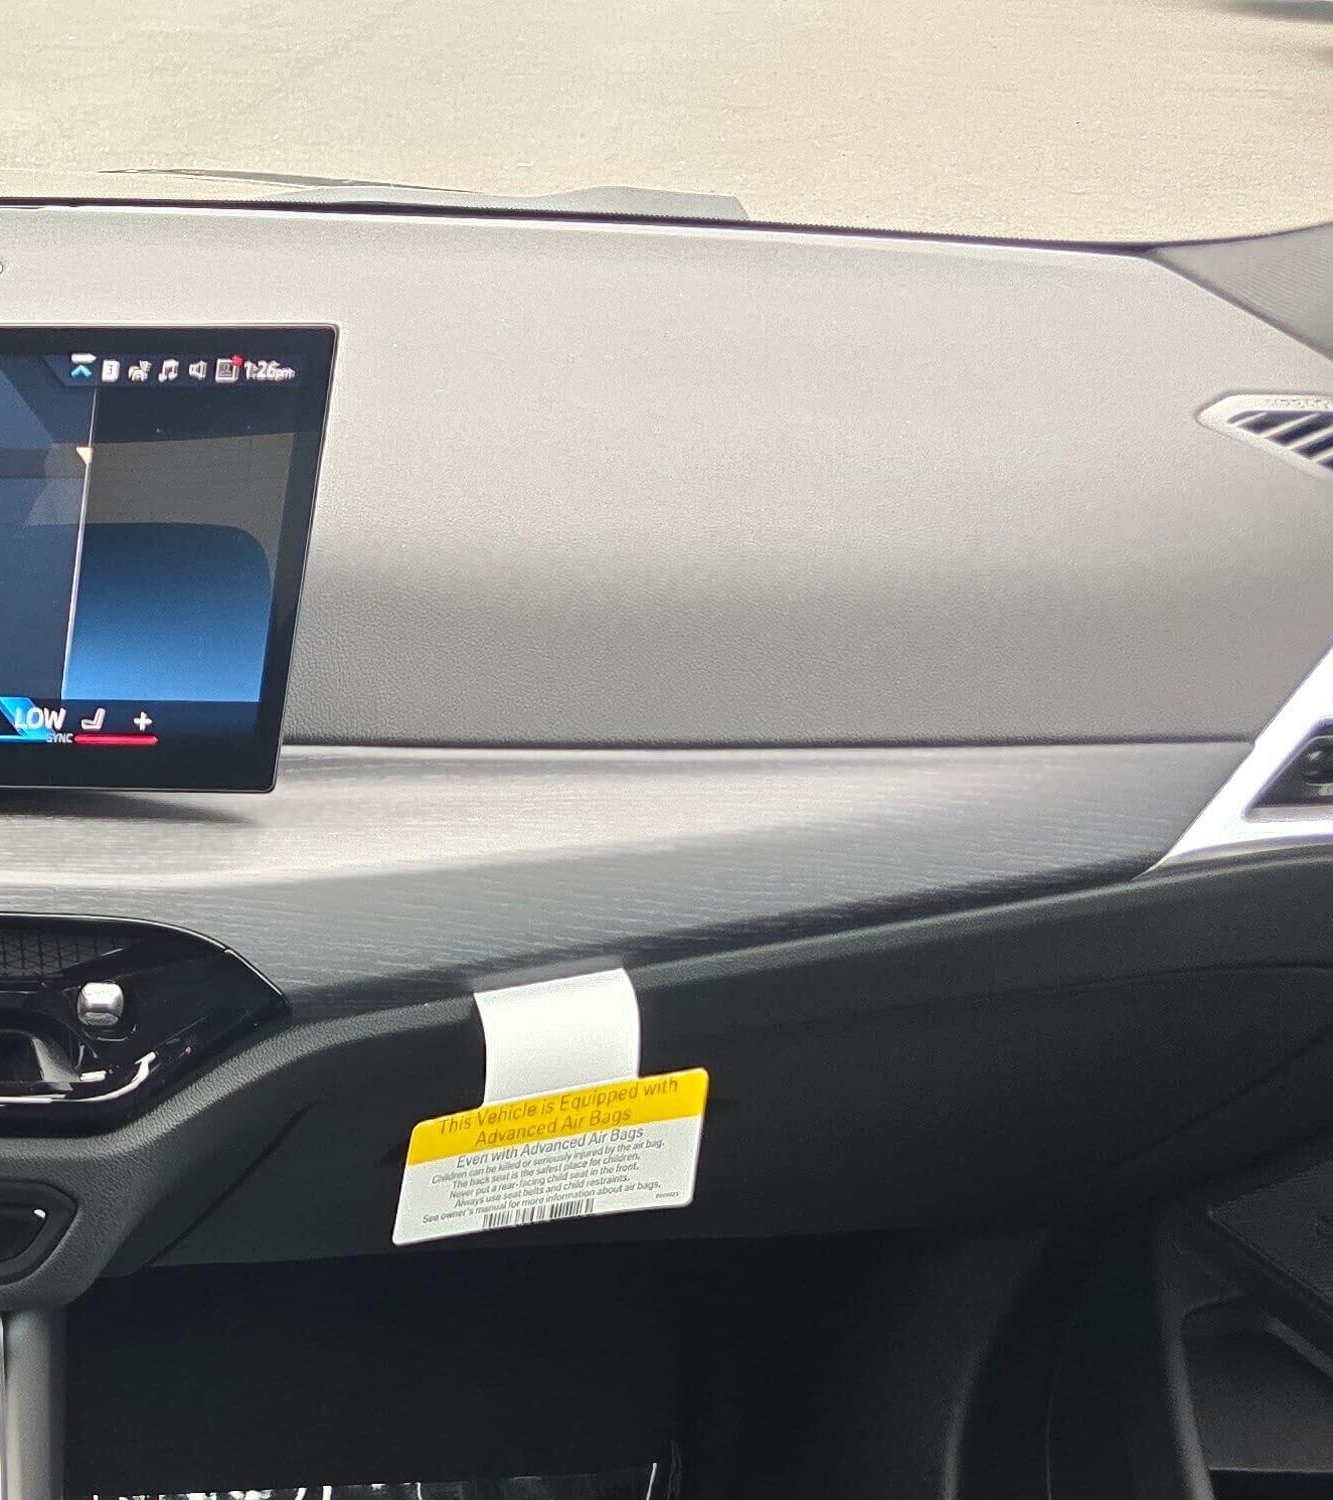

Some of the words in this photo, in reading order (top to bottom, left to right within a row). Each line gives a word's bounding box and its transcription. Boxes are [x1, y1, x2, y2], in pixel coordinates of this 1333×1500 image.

[15, 708, 66, 729] LOW
[438, 1116, 472, 1134] This
[475, 1102, 537, 1126] Vehicle
[540, 1099, 555, 1114] is
[559, 1083, 638, 1114] Equipped
[642, 1079, 678, 1097] with
[474, 1120, 557, 1146] Advanced
[560, 1114, 586, 1131] Air
[588, 1108, 631, 1130] Bags
[431, 1169, 467, 1183] Children
[468, 1168, 484, 1176] can
[498, 1159, 521, 1171] killed
[532, 1152, 572, 1167] seriously
[572, 1147, 603, 1160] injured
[616, 1142, 631, 1152] the
[645, 1137, 665, 1150] bag.
[456, 1153, 488, 1168] Even
[490, 1149, 518, 1161] with
[519, 1136, 586, 1156] Advanced
[587, 1132, 606, 1145] Air
[609, 1128, 644, 1144] Bags
[449, 1187, 474, 1199] Never
[475, 1185, 490, 1196] put
[616, 1161, 639, 1172] front.
[452, 1179, 468, 1189] The
[536, 1163, 561, 1174] safest
[603, 1151, 640, 1164] children.
[422, 1212, 439, 1222] See
[475, 1201, 506, 1213] manual
[545, 1188, 595, 1202] information
[596, 1184, 622, 1194] about
[636, 1179, 661, 1191] bags.
[454, 1195, 484, 1208] Always
[586, 1173, 630, 1186] restraints.
